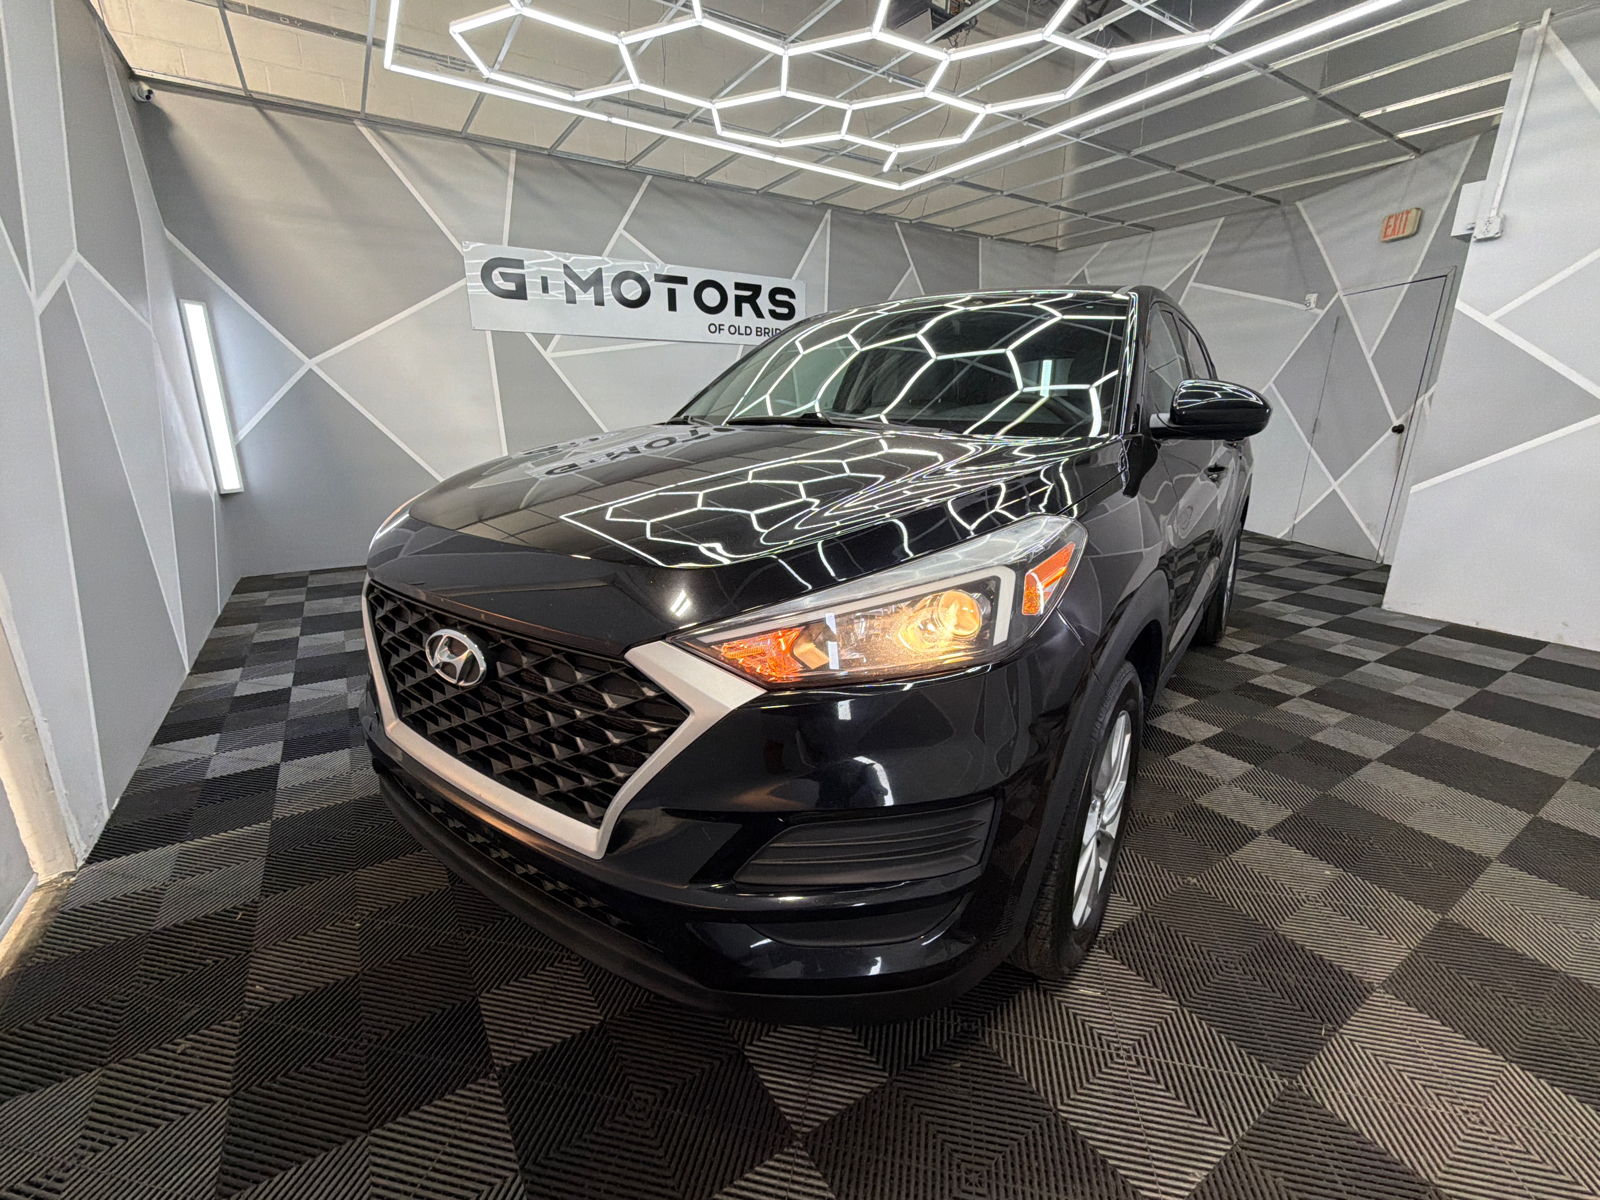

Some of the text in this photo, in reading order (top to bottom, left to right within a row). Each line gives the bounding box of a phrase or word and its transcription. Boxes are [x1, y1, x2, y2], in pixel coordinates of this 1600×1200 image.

[1384, 211, 1411, 237] EXIT
[708, 323, 725, 334] OF
[728, 324, 752, 336] OLD
